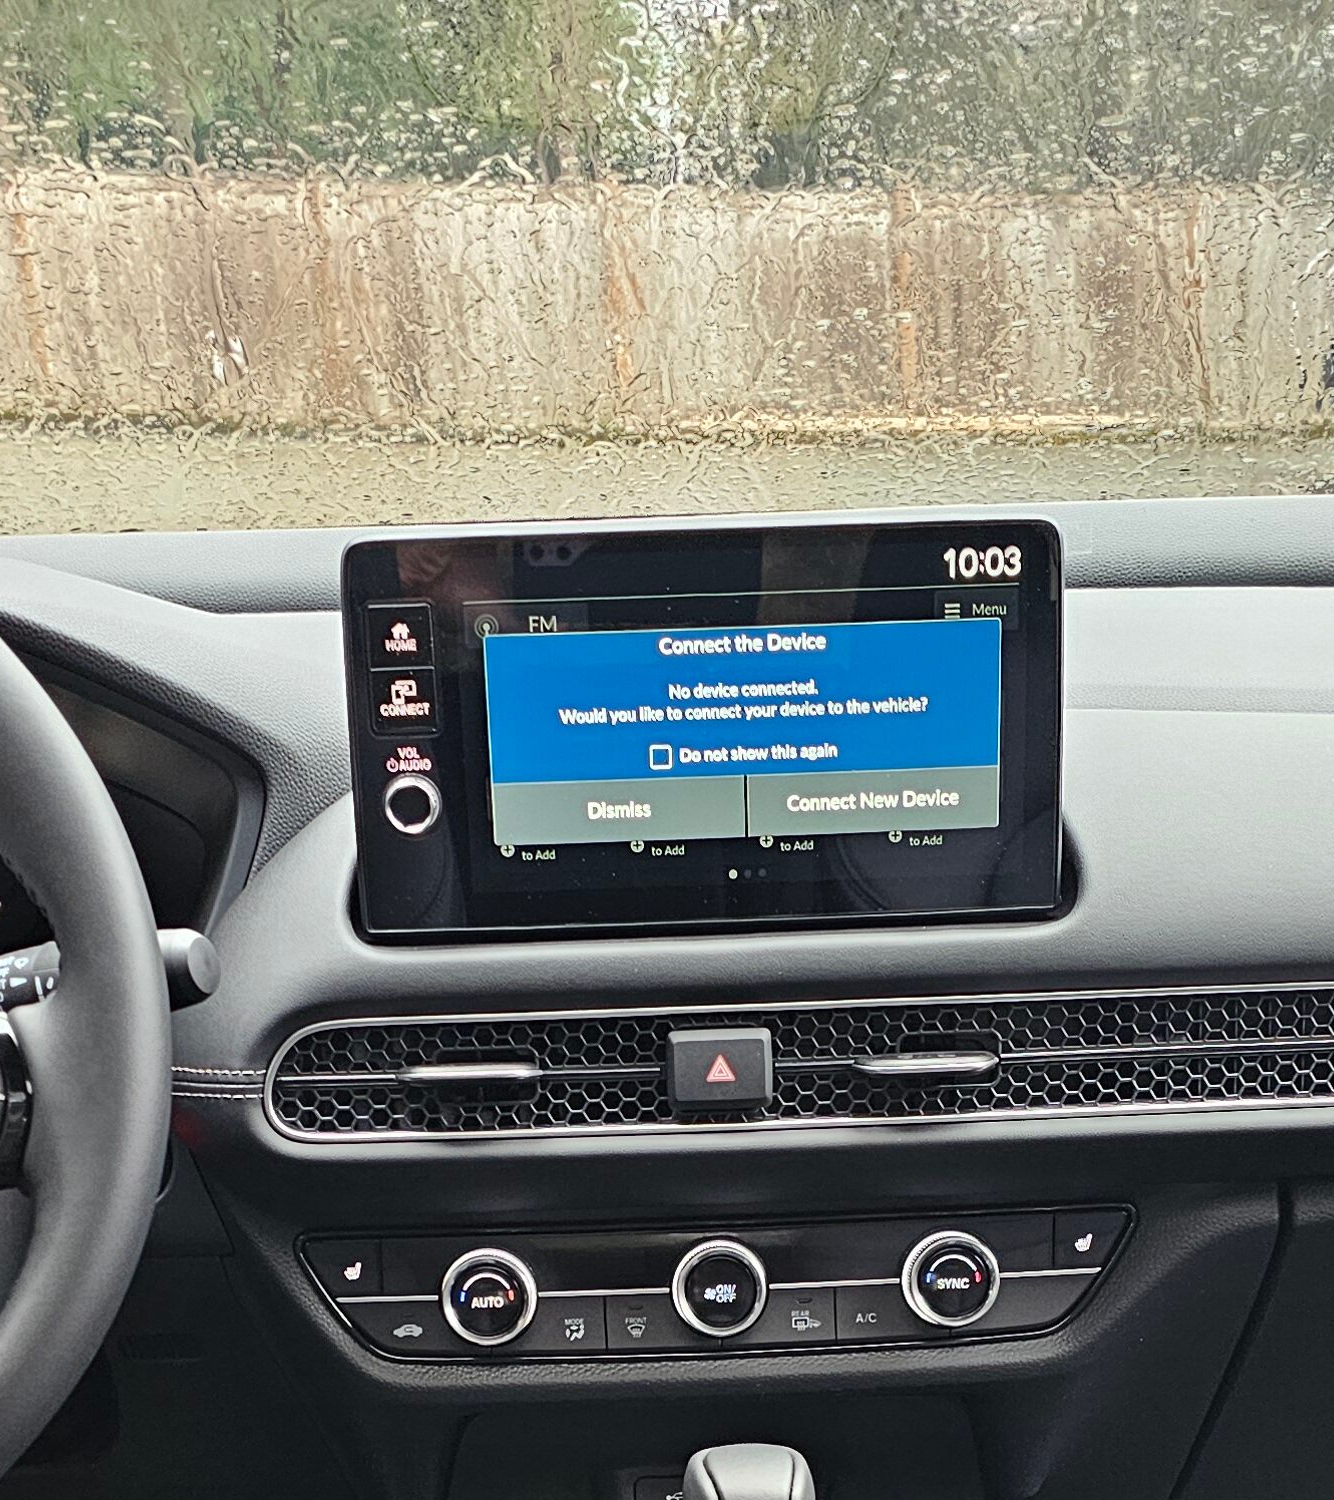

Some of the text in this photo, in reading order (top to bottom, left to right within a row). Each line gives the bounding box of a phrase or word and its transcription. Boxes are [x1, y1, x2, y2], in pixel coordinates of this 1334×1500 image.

[943, 545, 1022, 580] 10:03
[972, 603, 1007, 616] Menu
[528, 615, 558, 633] FM
[384, 638, 417, 652] HOME
[658, 632, 827, 656] Connect the Device
[668, 679, 819, 700] No device connected.
[379, 702, 430, 717] CONNECT
[559, 696, 929, 726] Would you like to connect your device to the vehicle?
[397, 747, 420, 758] VOL
[679, 742, 838, 763] Do not show this again
[399, 758, 432, 771] AUDIO
[787, 788, 960, 812] Connect New Device
[587, 800, 652, 820] Dismiss
[780, 840, 814, 852] to Add
[909, 834, 943, 848] to Add
[522, 849, 556, 861] to Add
[651, 844, 685, 857] to Add
[937, 1278, 970, 1290] SYNC
[471, 1296, 505, 1309] AUTO
[716, 1294, 736, 1303] OFF
[791, 1310, 810, 1318] REAR
[856, 1312, 877, 1324] A/C
[564, 1318, 584, 1326] MODE
[625, 1317, 647, 1325] FRONT
